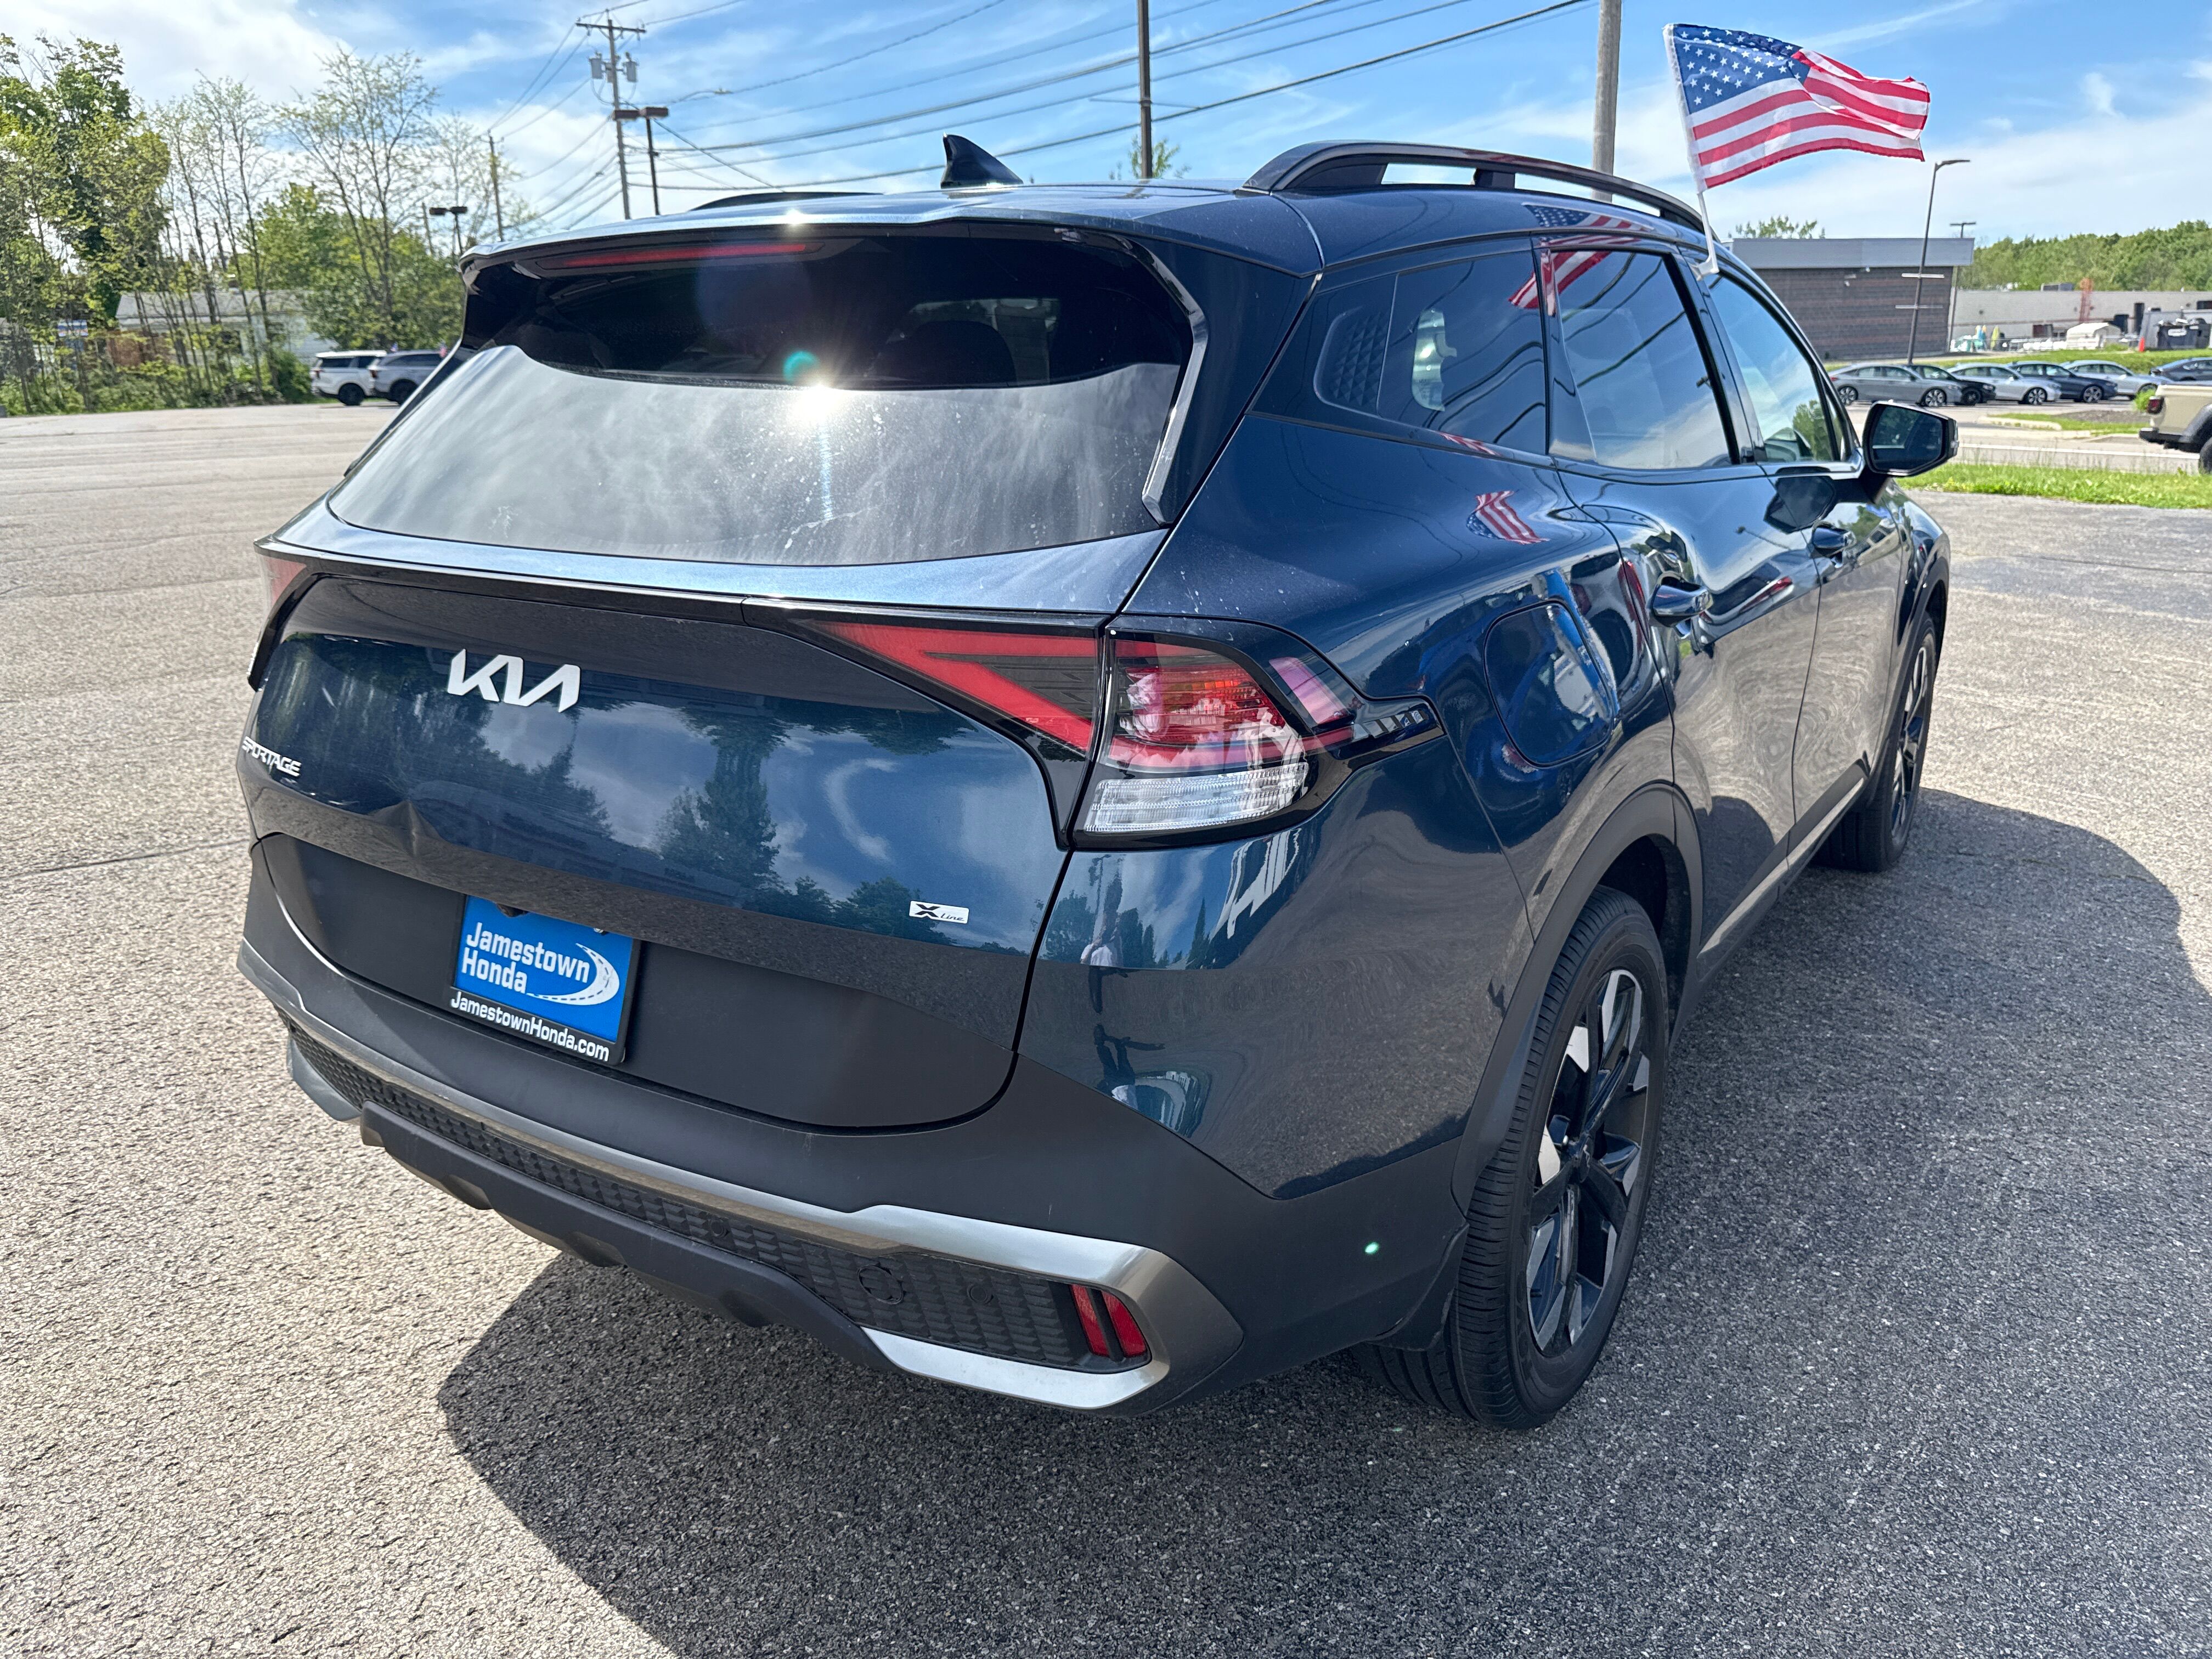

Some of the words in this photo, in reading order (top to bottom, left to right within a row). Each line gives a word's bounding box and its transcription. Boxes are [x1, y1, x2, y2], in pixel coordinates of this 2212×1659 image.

[447, 648, 582, 713] KIA
[242, 736, 302, 777] SPORTAGE
[462, 947, 528, 994] Honda
[466, 922, 590, 983] Jamestown
[450, 991, 610, 1062] JamestownHonda.com
